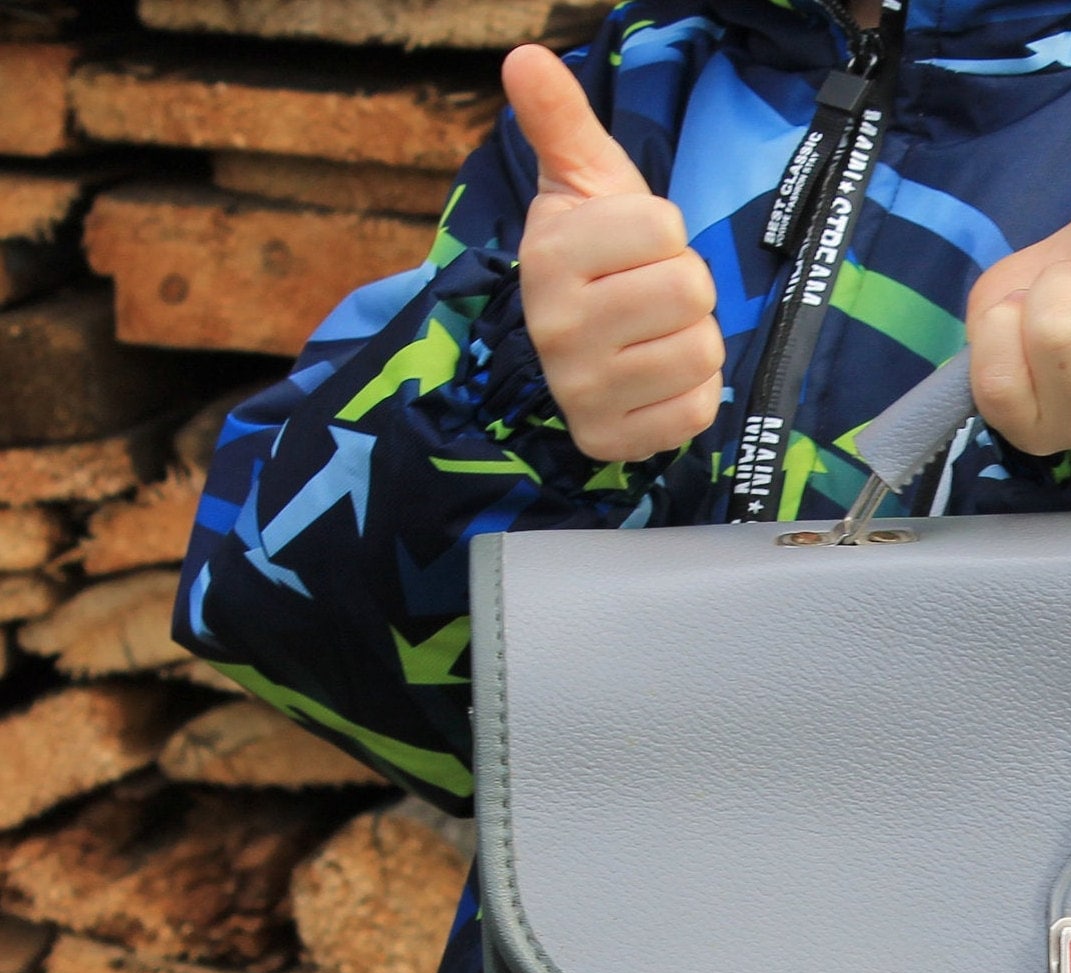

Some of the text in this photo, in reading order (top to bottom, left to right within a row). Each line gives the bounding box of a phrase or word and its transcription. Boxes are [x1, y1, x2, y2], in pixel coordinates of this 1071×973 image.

[763, 131, 824, 244] BEST CLASSIC
[734, 416, 784, 496] MAIN
